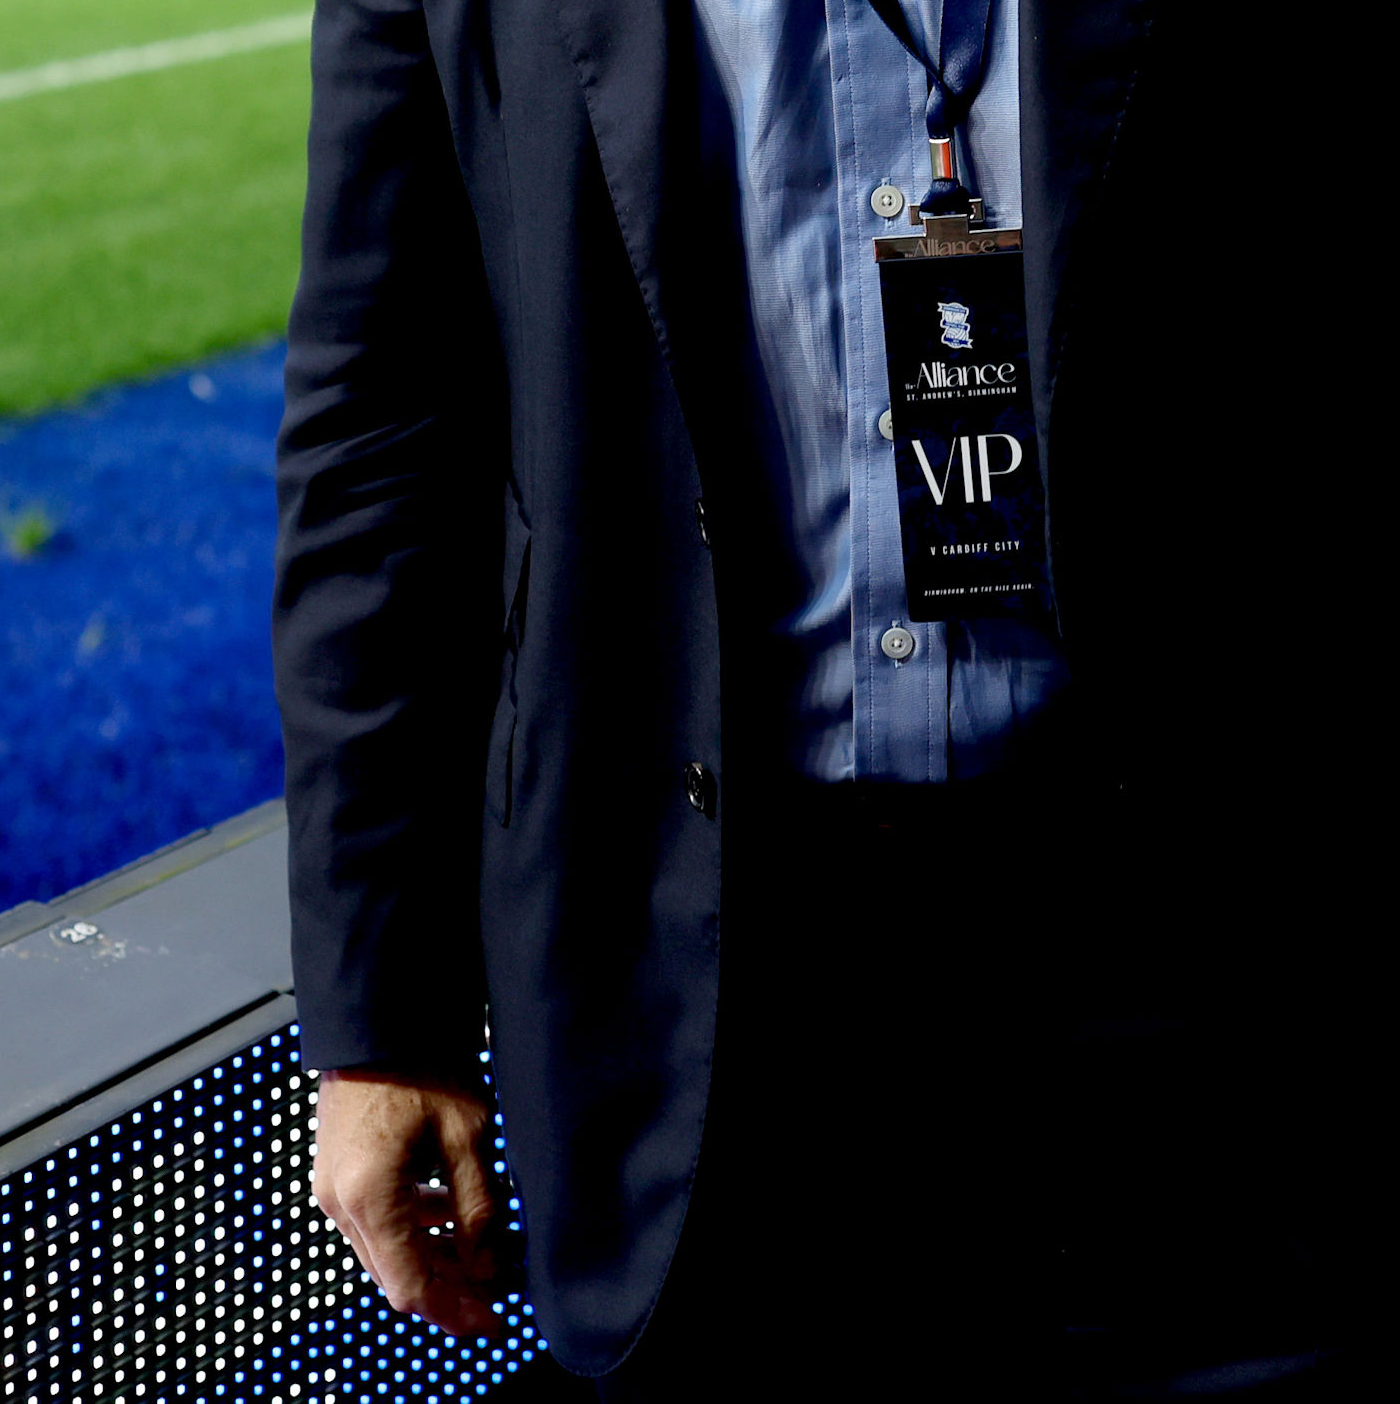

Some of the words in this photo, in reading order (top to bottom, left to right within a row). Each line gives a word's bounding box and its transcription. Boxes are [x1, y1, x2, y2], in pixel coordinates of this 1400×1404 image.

[916, 360, 1017, 389] Alliance
[967, 386, 1017, 397] BIRMINGHAM
[911, 433, 1023, 506] VIP
[930, 546, 936, 556] V
[942, 542, 988, 555] CARDIFF
[994, 540, 1020, 552] CITY
[980, 585, 992, 593] THE
[995, 584, 1009, 592] RISE
[60, 922, 98, 943] 26
